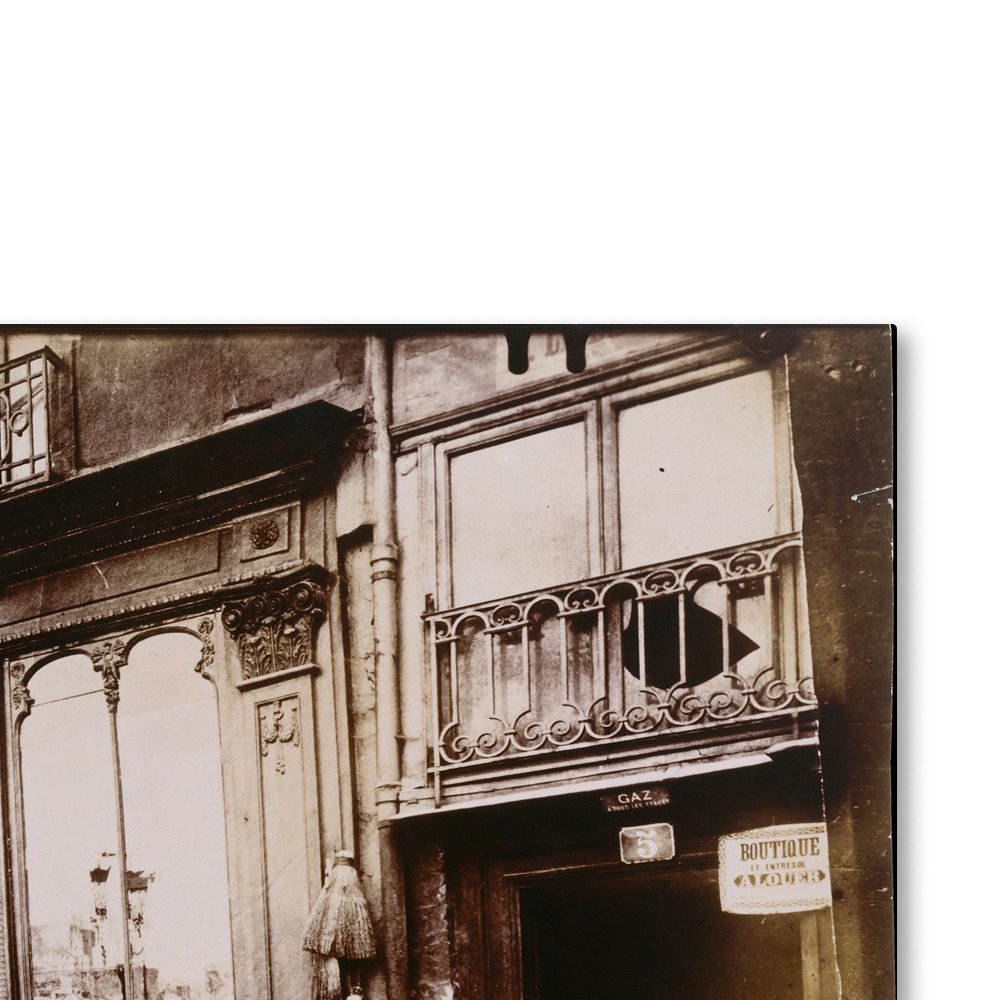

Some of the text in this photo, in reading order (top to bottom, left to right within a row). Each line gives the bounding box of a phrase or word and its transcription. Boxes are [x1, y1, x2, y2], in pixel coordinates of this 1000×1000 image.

[618, 790, 654, 805] GAZ
[635, 828, 659, 858] 5
[740, 837, 819, 861] BOUTIQUE
[766, 861, 806, 870] ENTRESOL
